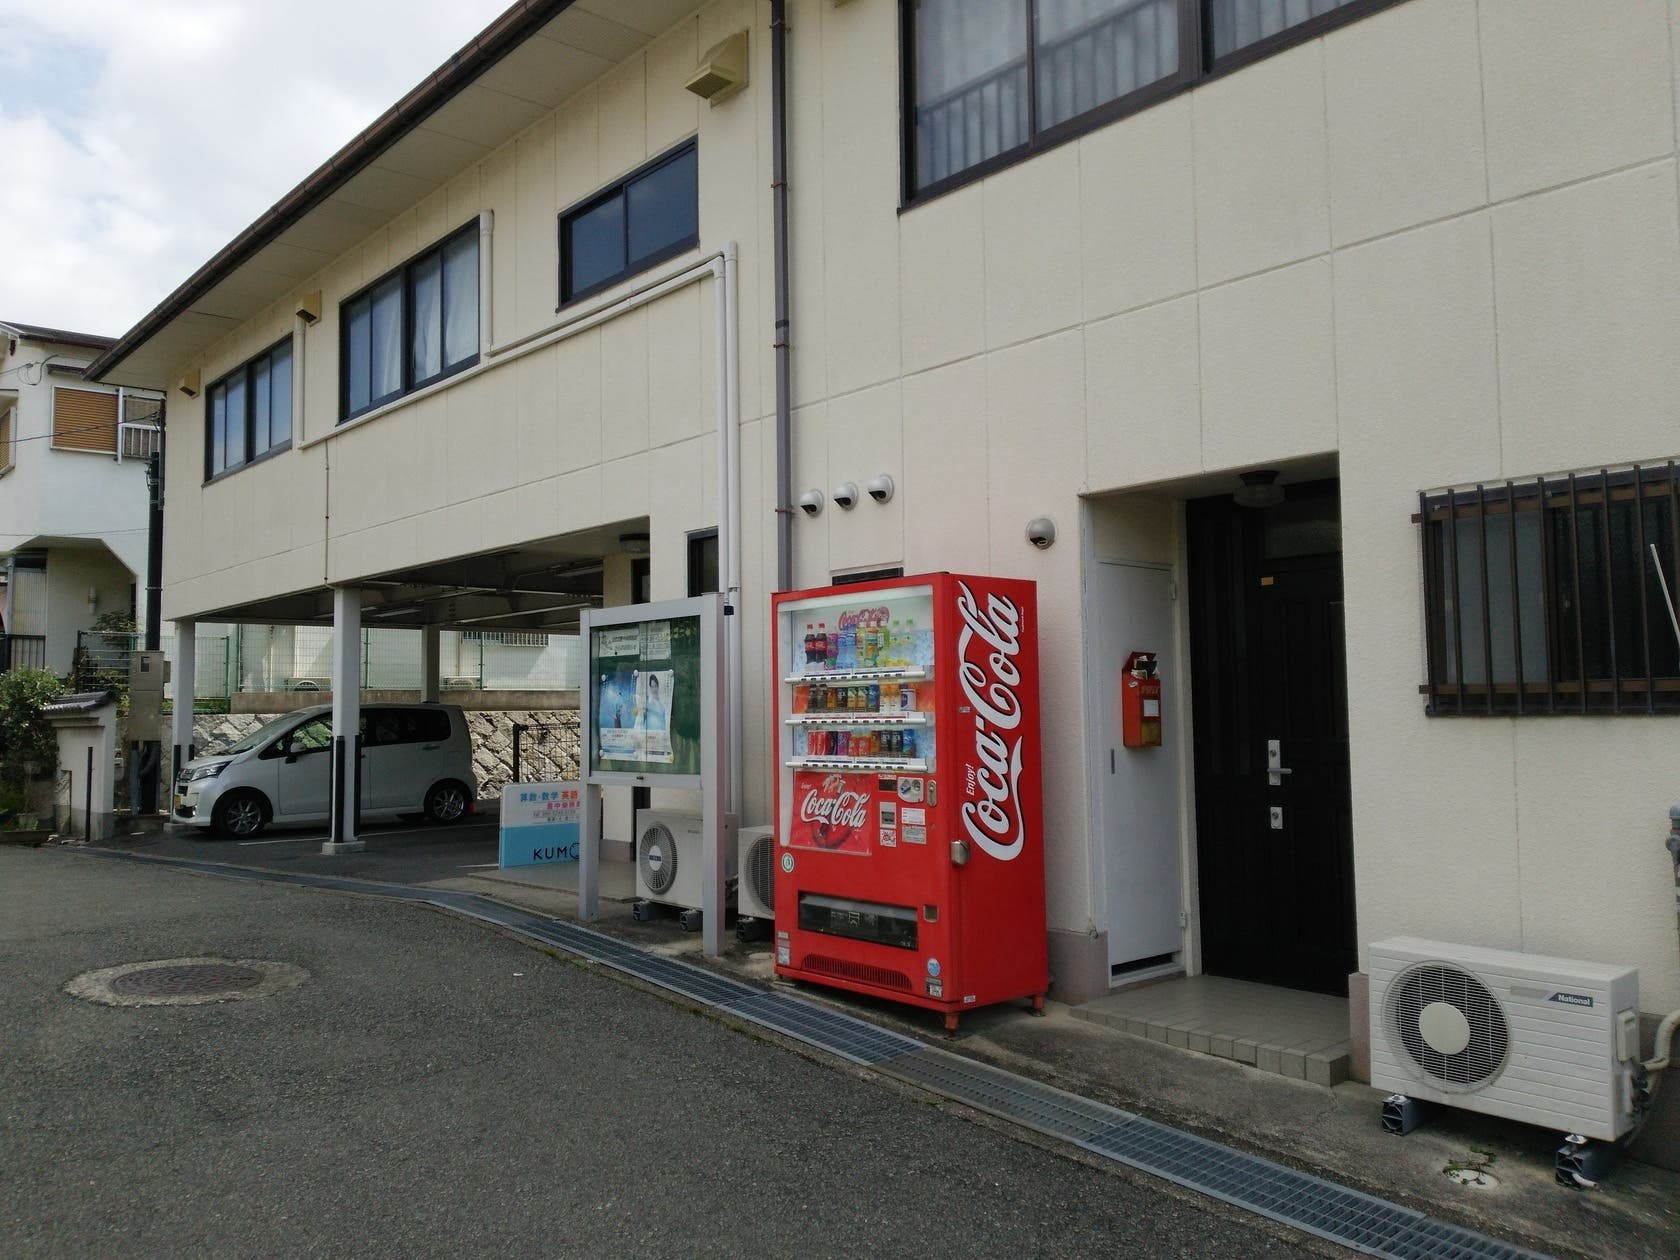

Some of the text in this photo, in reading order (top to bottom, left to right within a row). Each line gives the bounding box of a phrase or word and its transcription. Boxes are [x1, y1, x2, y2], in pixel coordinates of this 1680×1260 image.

[958, 581, 1024, 861] Coca-Cola
[965, 763, 976, 796] Enjoy!
[801, 790, 871, 828] Coca-Cola
[1558, 994, 1591, 1006] National
